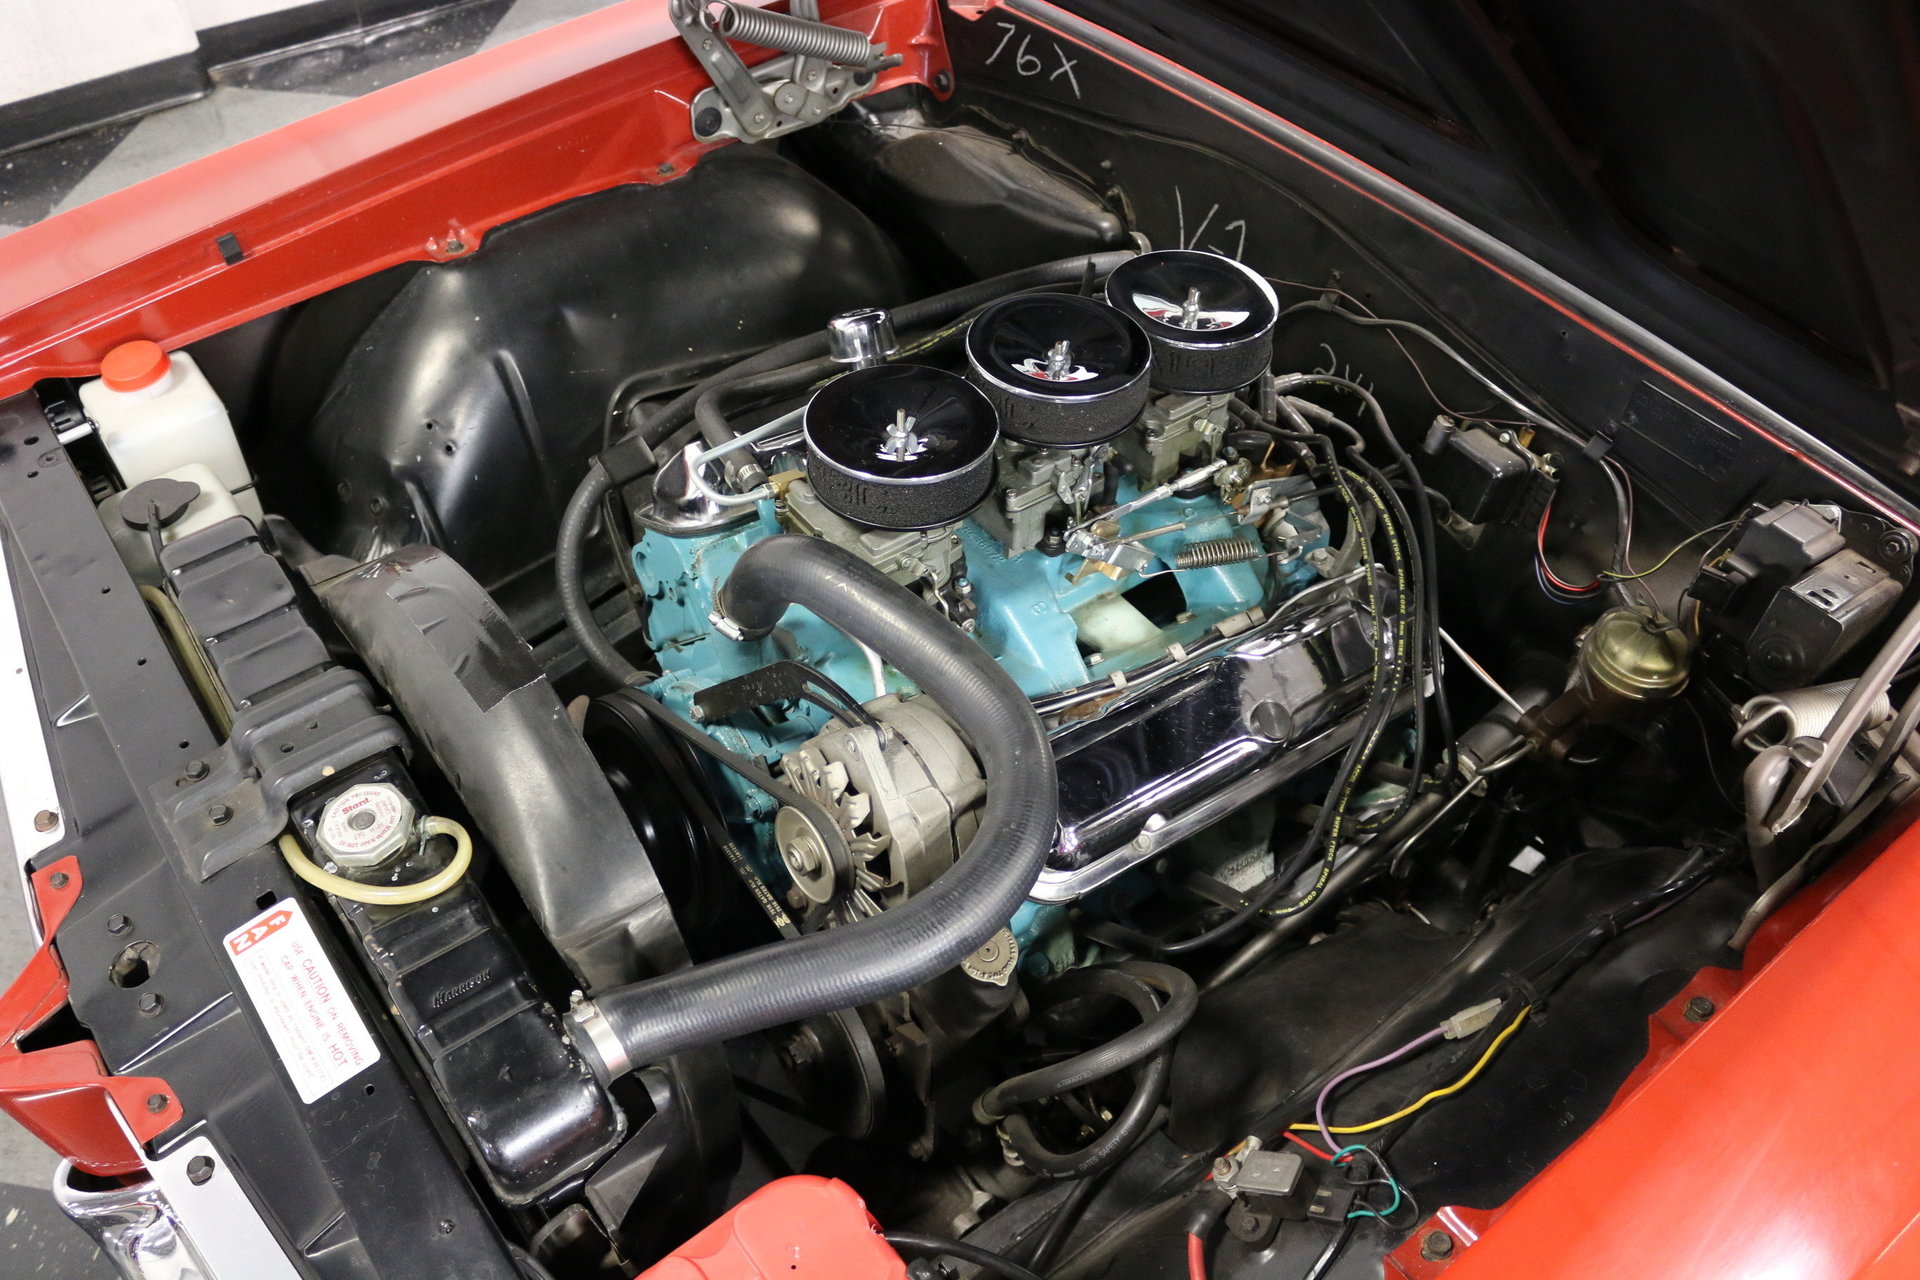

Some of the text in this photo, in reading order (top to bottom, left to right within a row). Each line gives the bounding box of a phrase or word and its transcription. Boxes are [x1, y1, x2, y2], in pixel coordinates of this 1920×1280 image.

[1360, 537, 1369, 560] SUPER
[1382, 513, 1395, 536] SUPER
[1392, 538, 1402, 561] STOCK
[1398, 568, 1406, 591] SPIRAL
[342, 798, 370, 814] Stant
[360, 838, 376, 846] OPEN
[1316, 868, 1330, 888] SPIRAL
[754, 888, 768, 903] GATES
[760, 885, 774, 901] GATES
[1298, 890, 1316, 908] CORE
[232, 914, 288, 952] FAN
[280, 954, 294, 972] CAP
[290, 975, 307, 998] WHEN
[304, 1000, 323, 1030] ENGINE
[322, 1032, 330, 1042] IS
[328, 1043, 348, 1068] HOT
[291, 940, 363, 1066] USE CAUTION ON REMOVING
[1078, 1136, 1121, 1171] GATES SAFETY
